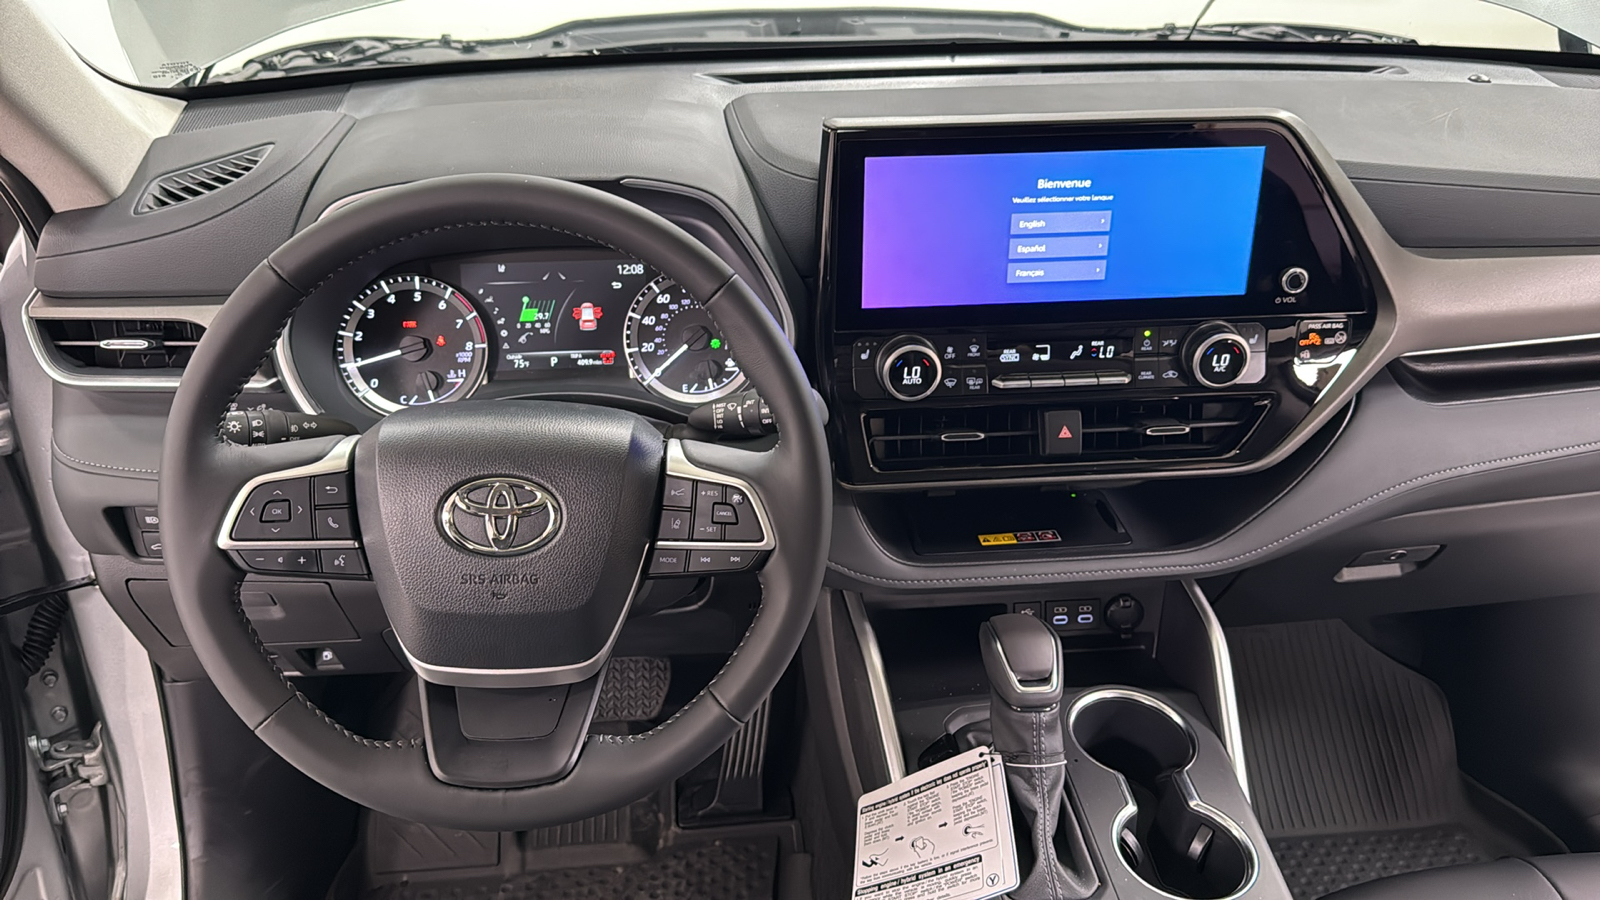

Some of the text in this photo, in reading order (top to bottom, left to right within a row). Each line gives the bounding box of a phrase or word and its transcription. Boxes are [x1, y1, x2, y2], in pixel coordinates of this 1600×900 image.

[1037, 178, 1092, 189] Bienvenue
[1019, 220, 1045, 229] English
[1017, 245, 1046, 253] Español
[617, 264, 644, 275] 12:08
[387, 294, 396, 304] 4
[413, 292, 421, 302] 5
[656, 294, 670, 303] 60
[438, 300, 446, 310] 6
[367, 309, 375, 319] 3
[456, 320, 464, 329] 7
[642, 316, 655, 325] 40
[354, 332, 363, 341] 2
[465, 342, 474, 351] 8
[641, 343, 654, 352] 20
[551, 357, 558, 367] P
[370, 379, 379, 388] 0
[682, 384, 688, 392] E
[400, 396, 407, 404] C
[460, 574, 539, 585] SRS AIRBAG
[857, 886, 877, 897] Stopping
[953, 857, 979, 868] emergency
